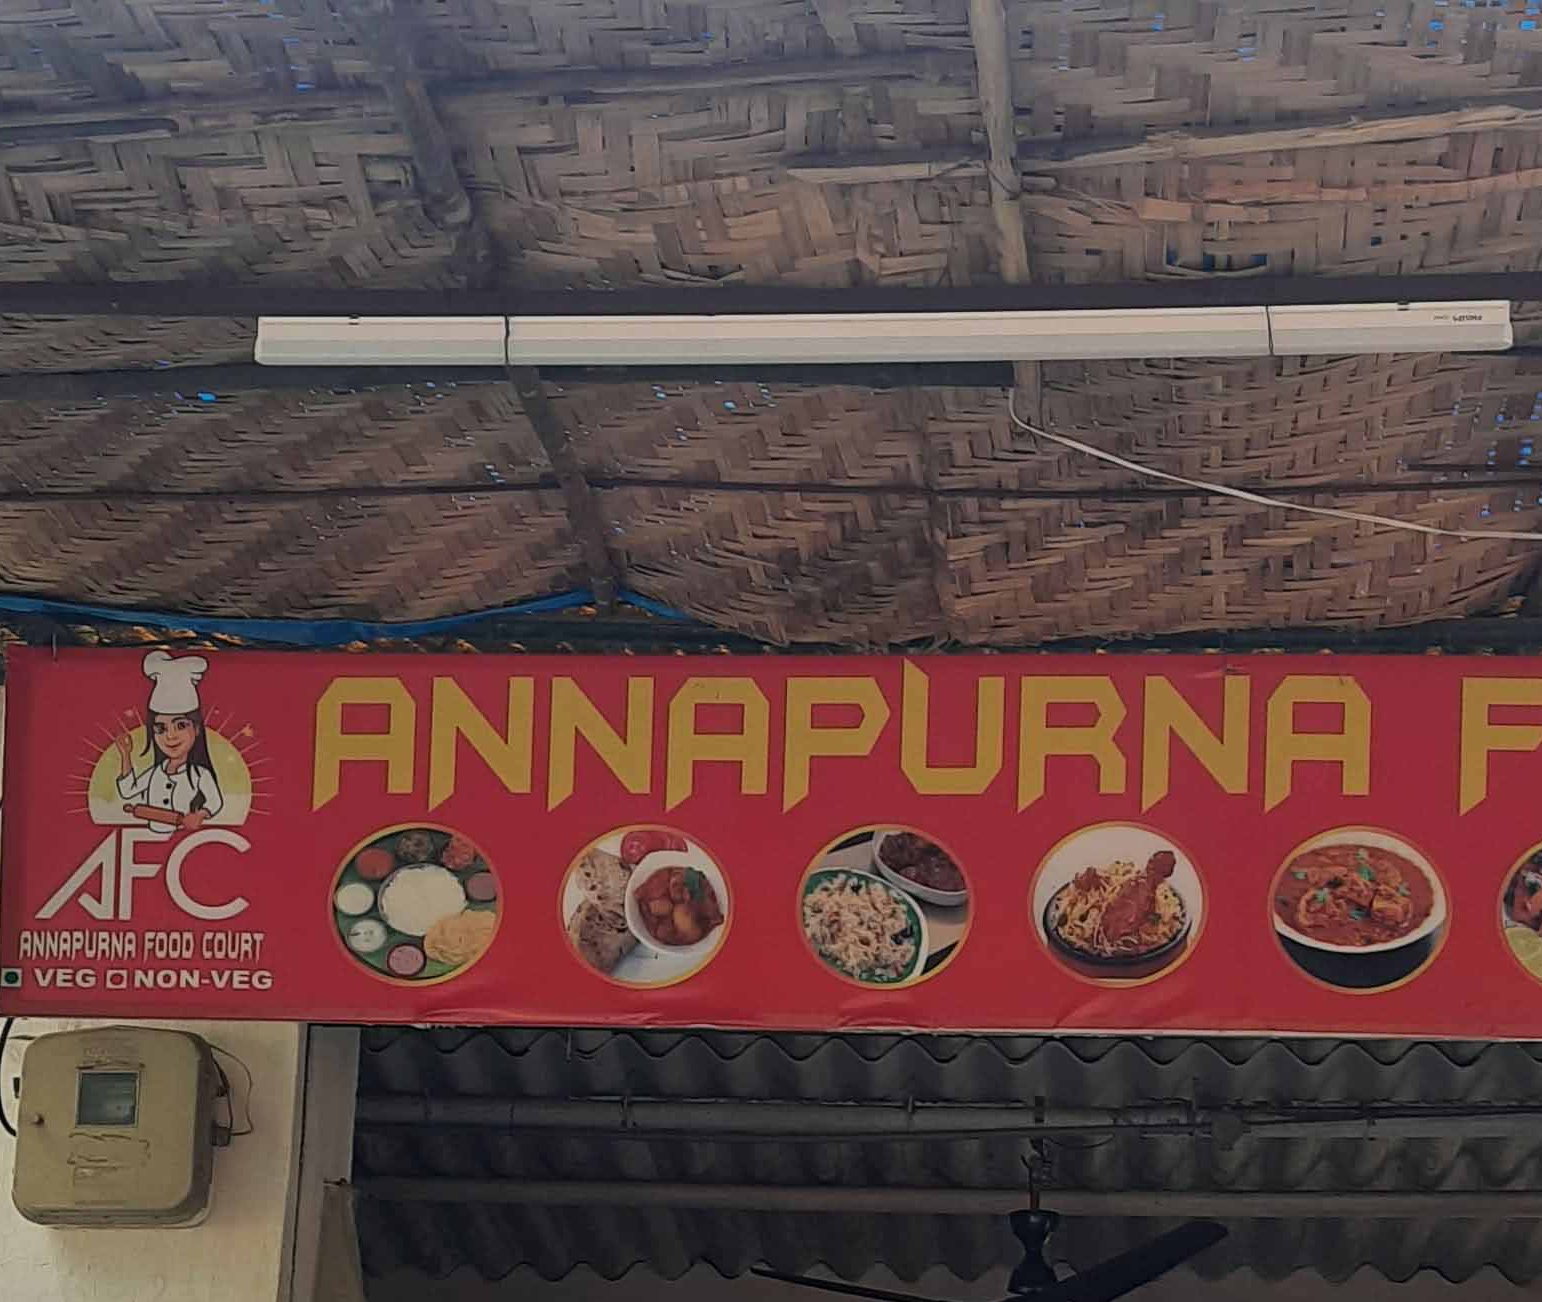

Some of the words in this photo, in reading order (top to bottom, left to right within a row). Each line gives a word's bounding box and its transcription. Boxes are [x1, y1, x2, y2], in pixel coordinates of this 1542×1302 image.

[311, 658, 1372, 813] ANNAPURNA
[34, 828, 252, 921] AFC
[18, 929, 136, 961] ANNAPURNA
[142, 930, 195, 961] FOOD
[202, 930, 264, 962] COURT
[34, 967, 97, 987] VEG
[134, 969, 274, 989] NON-VEG
